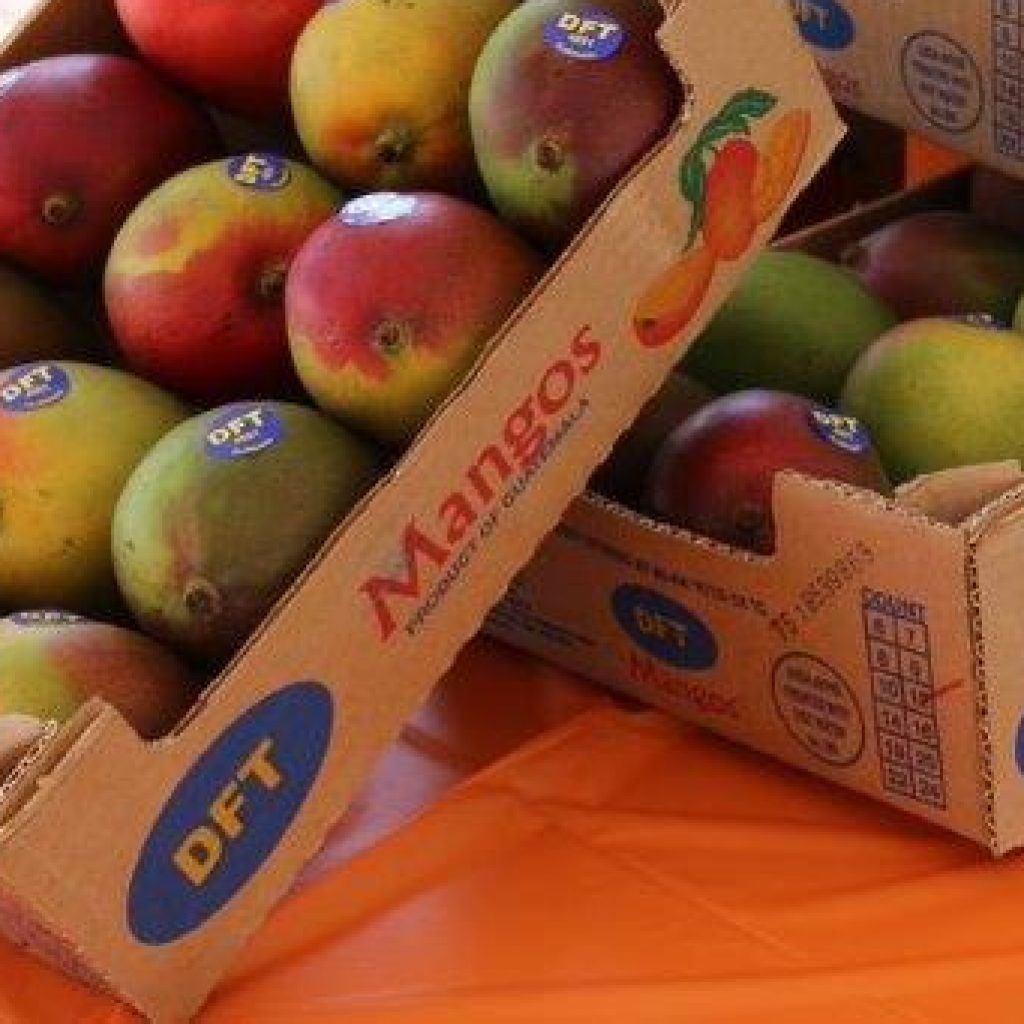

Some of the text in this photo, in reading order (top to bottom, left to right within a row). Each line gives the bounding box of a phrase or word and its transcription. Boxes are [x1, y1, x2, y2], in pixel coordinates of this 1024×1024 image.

[555, 12, 619, 40] DFT
[2, 365, 52, 403] DFT
[208, 408, 262, 446] DFT
[359, 323, 601, 643] Mangos
[172, 737, 287, 888] DFT
